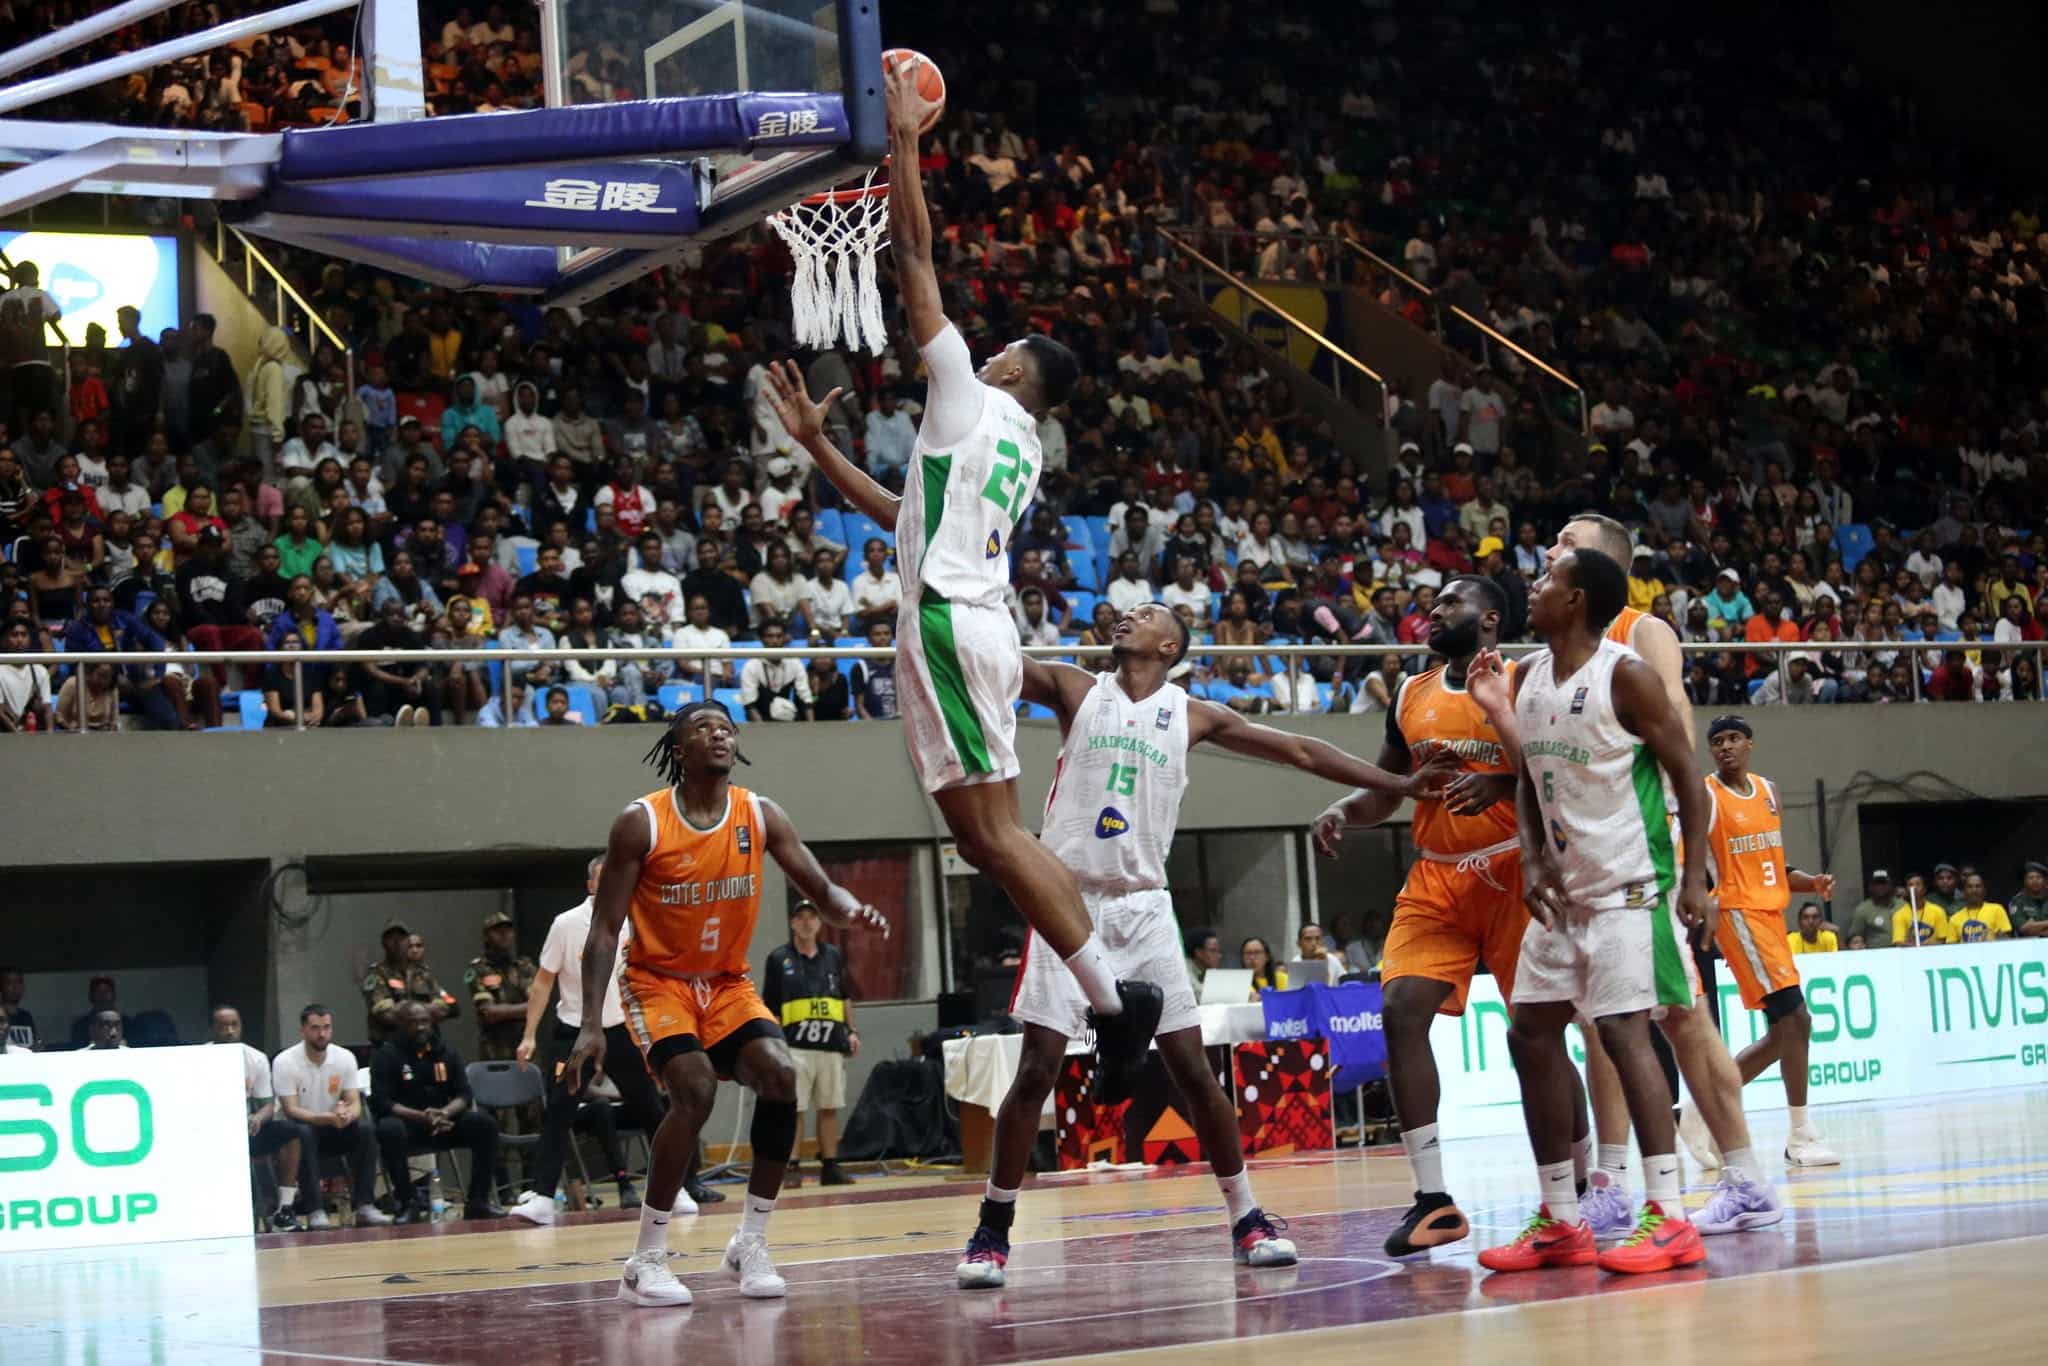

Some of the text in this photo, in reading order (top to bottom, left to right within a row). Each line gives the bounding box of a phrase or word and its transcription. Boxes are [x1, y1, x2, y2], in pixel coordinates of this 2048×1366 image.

[748, 110, 835, 140] 金陵
[525, 178, 677, 213] 金陵
[1105, 762, 1138, 796] 15
[1762, 862, 1776, 887] 3
[810, 1001, 829, 1017] HB
[796, 1020, 834, 1043] 787
[1808, 1059, 1881, 1086] GROUP
[0, 1192, 158, 1230] ROUP
